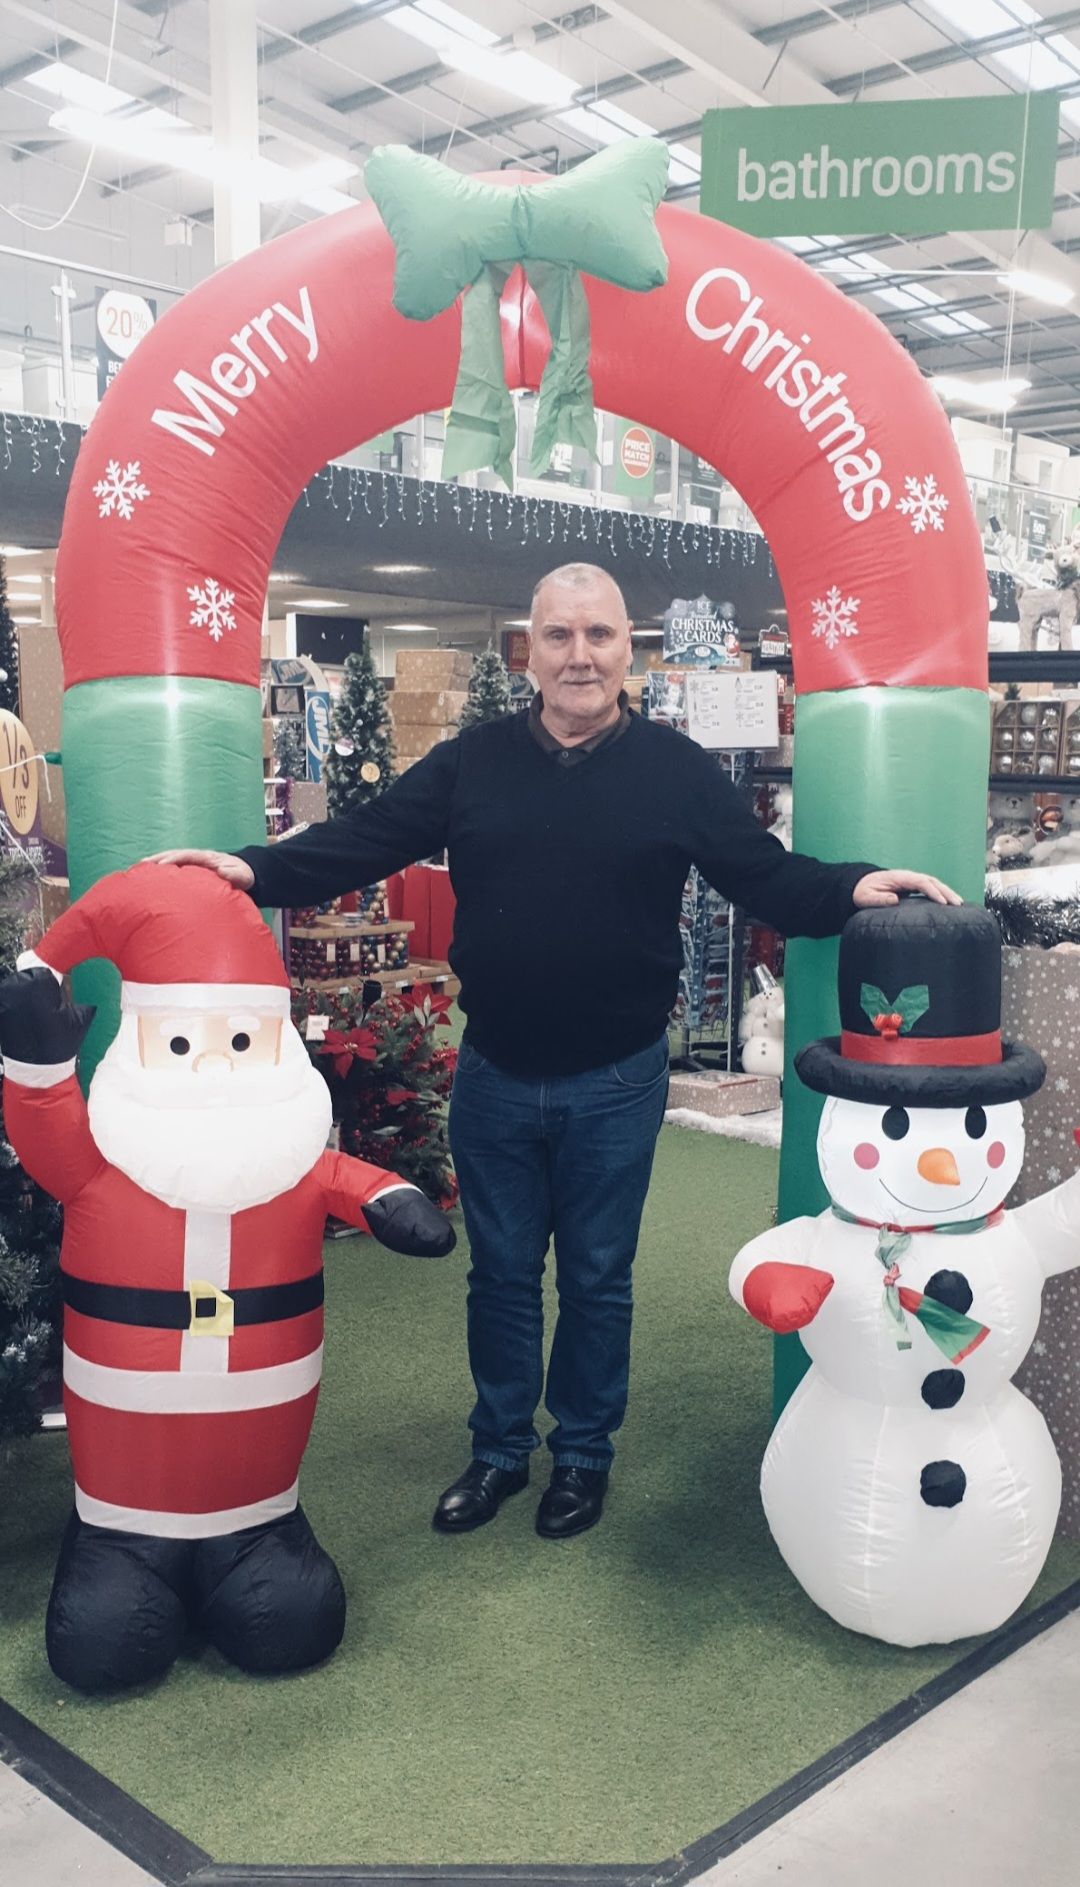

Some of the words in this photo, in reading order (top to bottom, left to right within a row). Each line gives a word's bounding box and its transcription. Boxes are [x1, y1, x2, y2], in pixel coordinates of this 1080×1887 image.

[737, 145, 1017, 202] bathrooms
[151, 286, 319, 457] Merry
[685, 267, 892, 522] Christmas
[625, 439, 650, 453] PRICE
[671, 617, 735, 633] CHRISTMAS
[684, 630, 722, 644] CARDS
[14, 796, 27, 819] OFF
